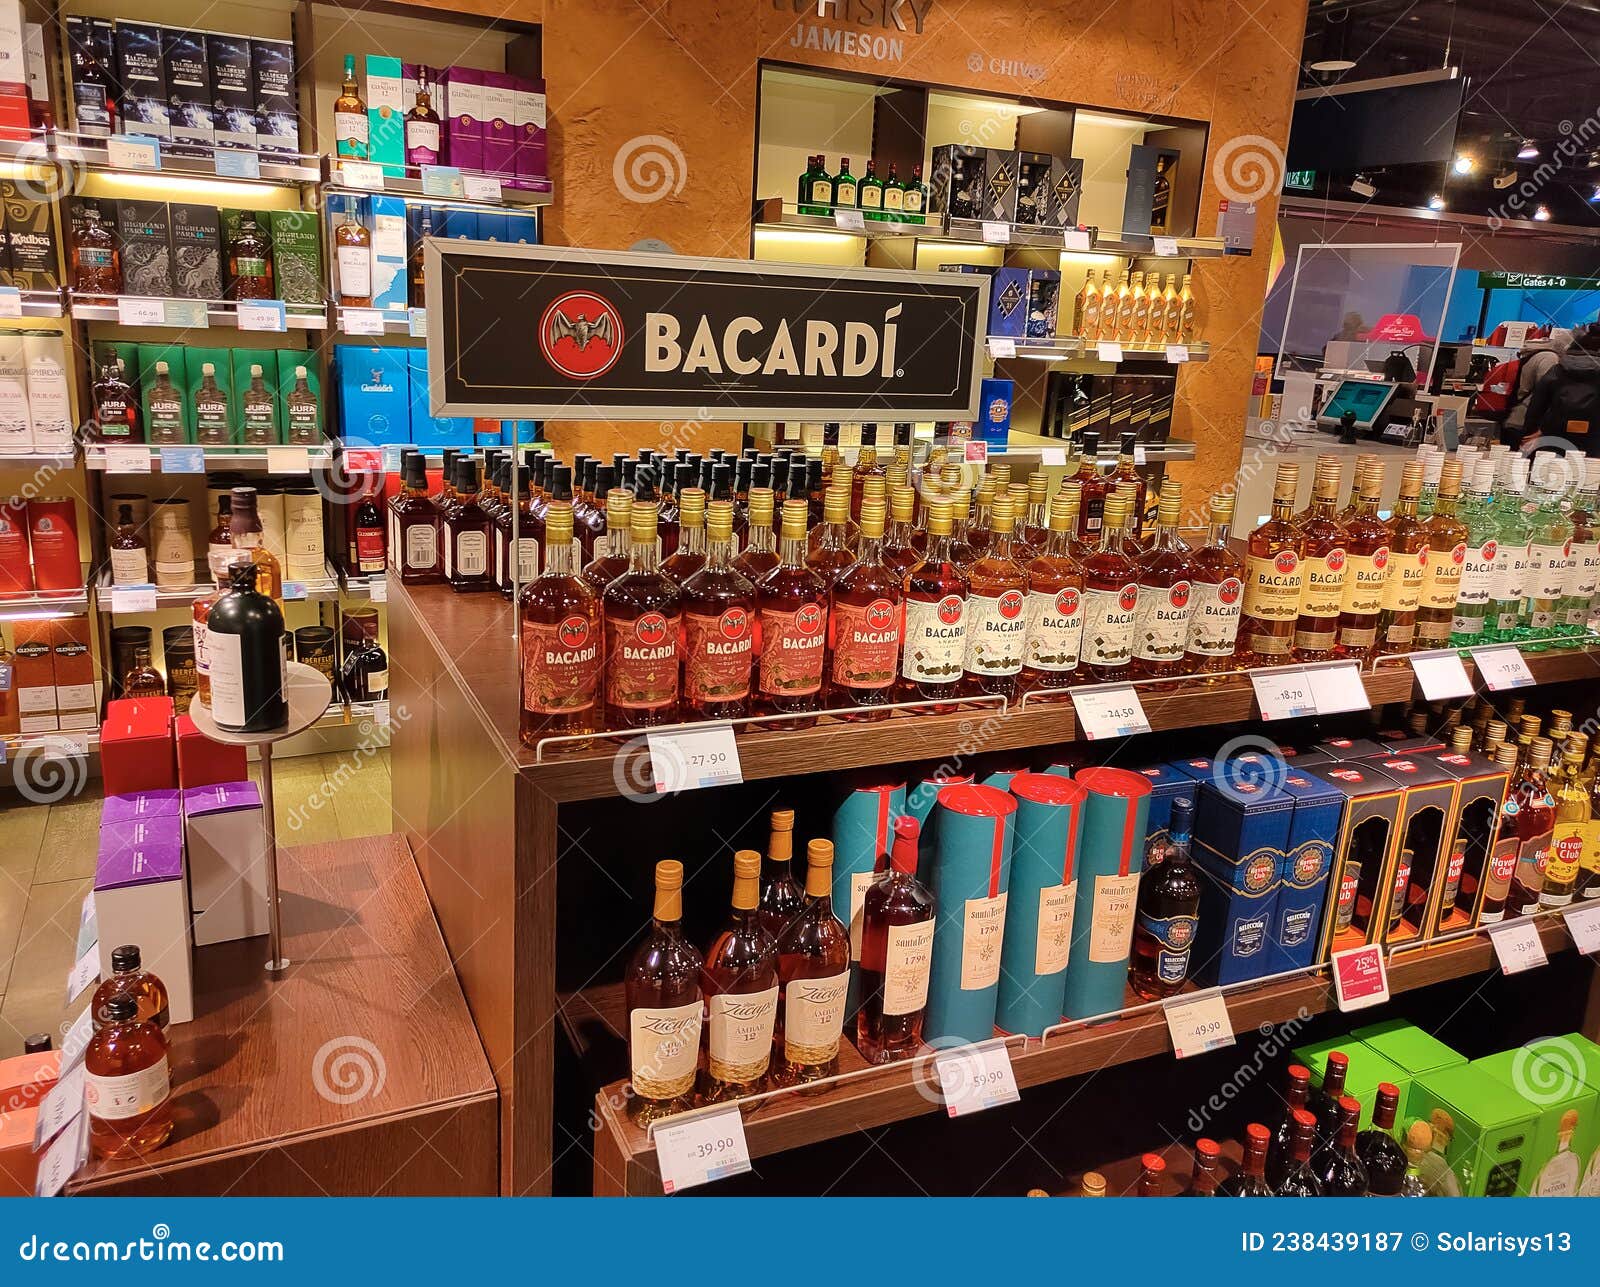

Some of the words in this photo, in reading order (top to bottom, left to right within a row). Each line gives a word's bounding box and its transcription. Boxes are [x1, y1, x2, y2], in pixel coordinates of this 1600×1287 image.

[789, 23, 905, 63] JAMESON
[1523, 279, 1547, 287] Gates
[1547, 279, 1554, 287] 4
[645, 302, 904, 376] BACARDÍ
[101, 400, 127, 409] JURA
[151, 402, 180, 412] JURA
[198, 402, 226, 412] JURA
[245, 403, 273, 413] JURA
[291, 404, 316, 413] JURA
[307, 544, 317, 552] 12
[1004, 643, 1011, 652] 4
[1060, 640, 1067, 648] 4
[545, 642, 597, 666] BACARDÍ
[623, 641, 675, 661] BACARDÍ
[944, 650, 951, 658] 4
[570, 676, 579, 686] 4
[646, 672, 656, 682] 4
[1280, 689, 1303, 701] 18.70
[1107, 707, 1135, 719] 24.50
[691, 751, 727, 768] 27.90
[1559, 849, 1579, 861] Club
[1566, 865, 1572, 873] 3
[1109, 902, 1129, 912] 1796
[980, 924, 999, 936] 1796
[904, 954, 927, 966] 1796
[819, 1014, 832, 1025] 12
[1194, 1020, 1221, 1037] 49.90
[743, 1032, 757, 1042] 12
[665, 1047, 679, 1058] 12
[972, 1069, 1004, 1088] 59.90
[696, 1136, 735, 1158] 39.90
